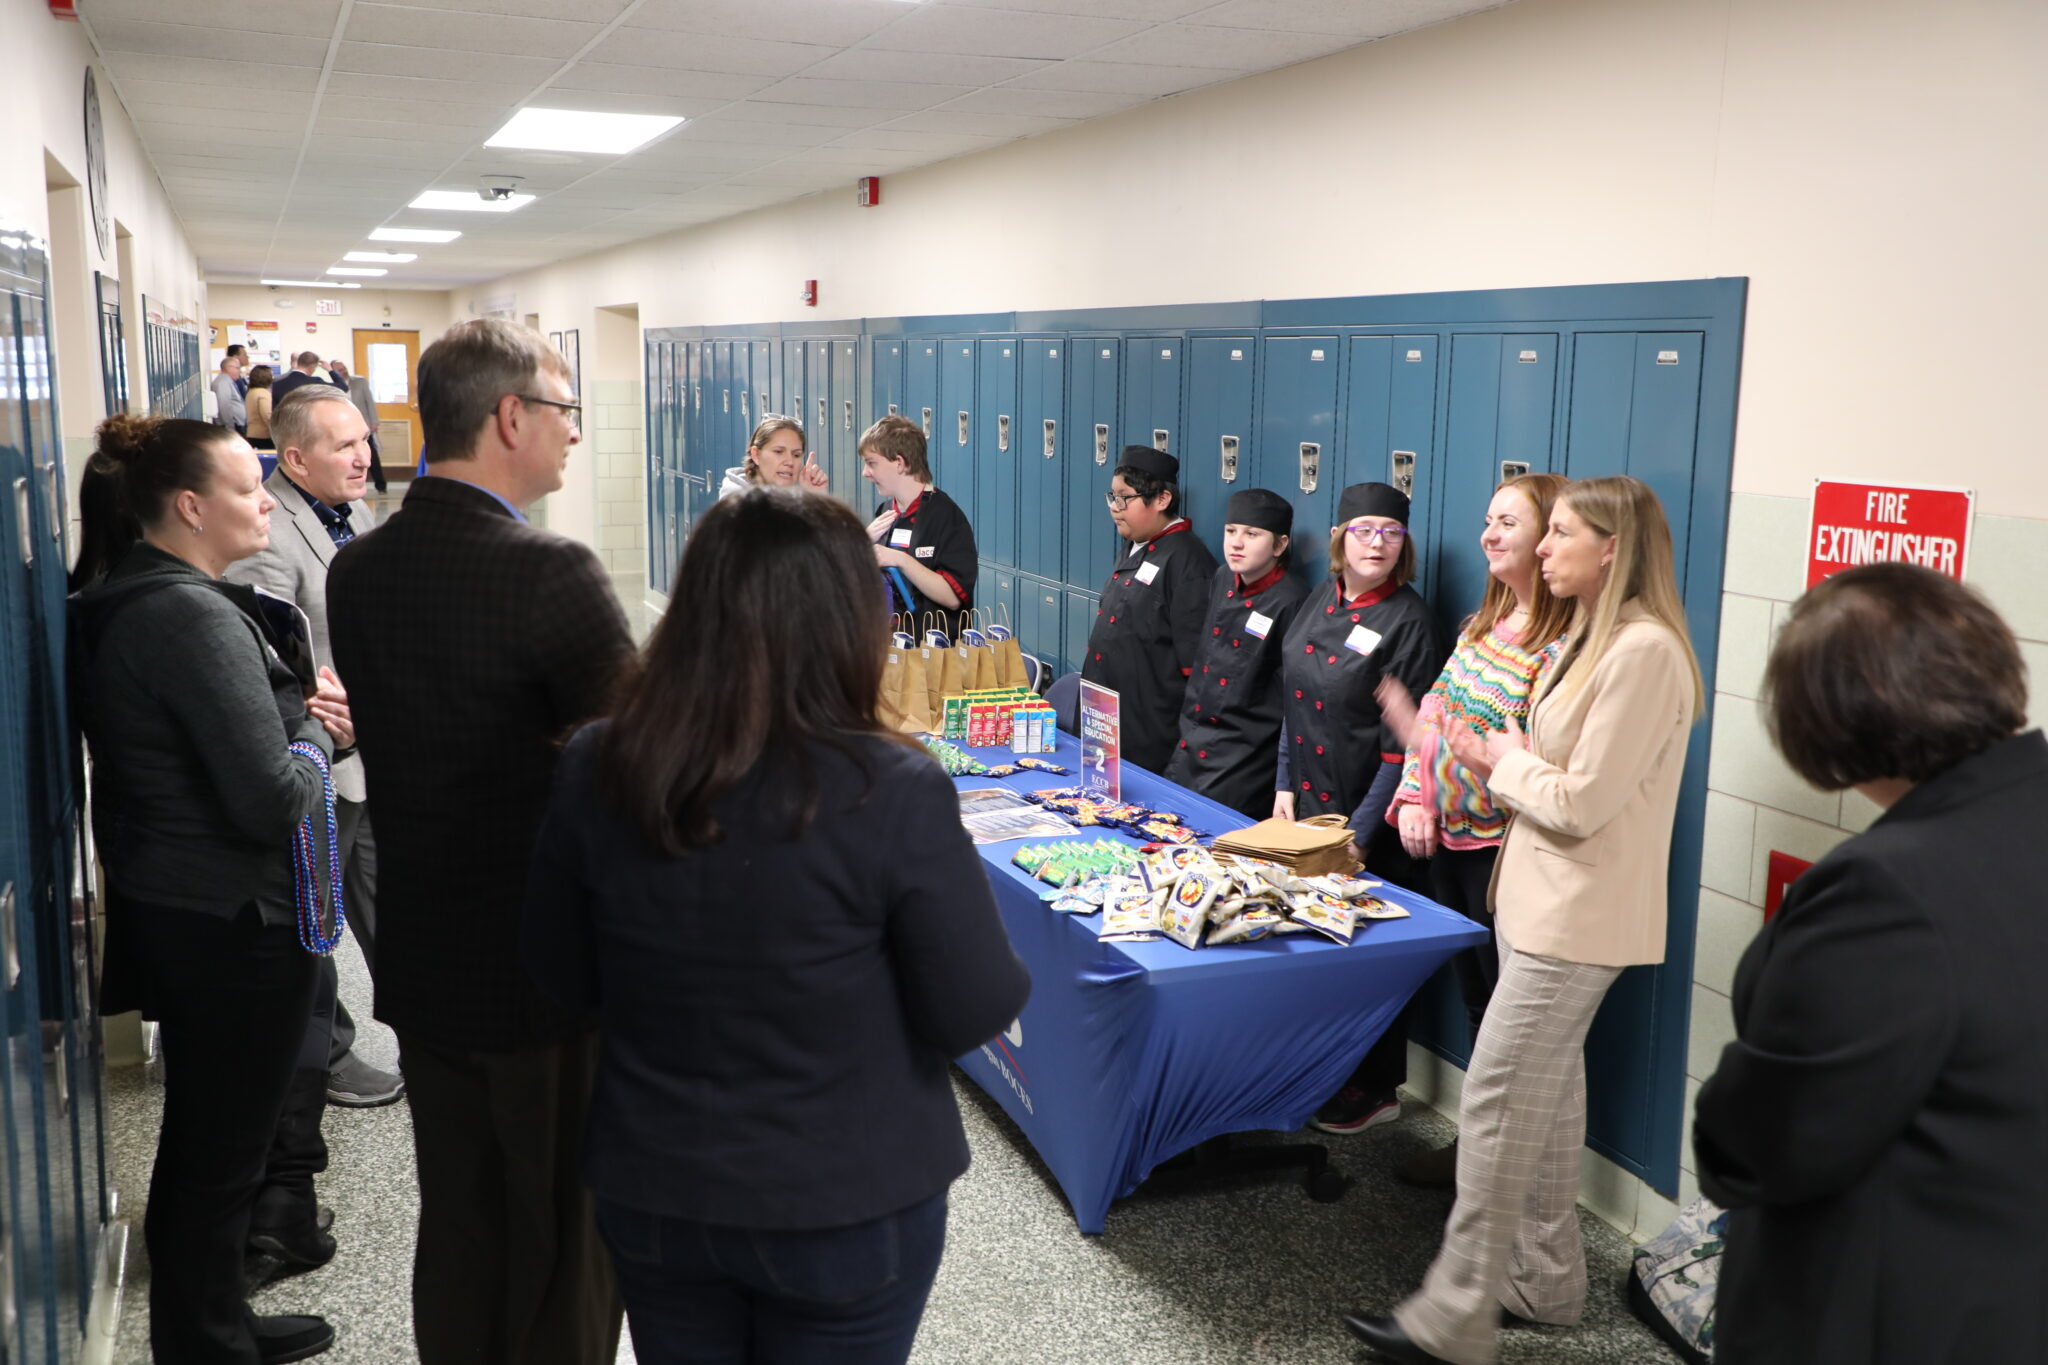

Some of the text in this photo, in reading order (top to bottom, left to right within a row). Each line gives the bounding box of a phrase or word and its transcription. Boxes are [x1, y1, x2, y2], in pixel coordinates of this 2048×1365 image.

[319, 301, 337, 314] EXIT
[1865, 491, 1910, 523] FIRE
[1815, 525, 1957, 576] EXTINGUISHER
[1083, 705, 1119, 726] ALTERNATIVE
[1086, 717, 1112, 735] & SPECIAL
[1084, 728, 1115, 745] EDUCATION
[1095, 747, 1105, 773] 2
[1000, 1059, 1033, 1115] BOCES
